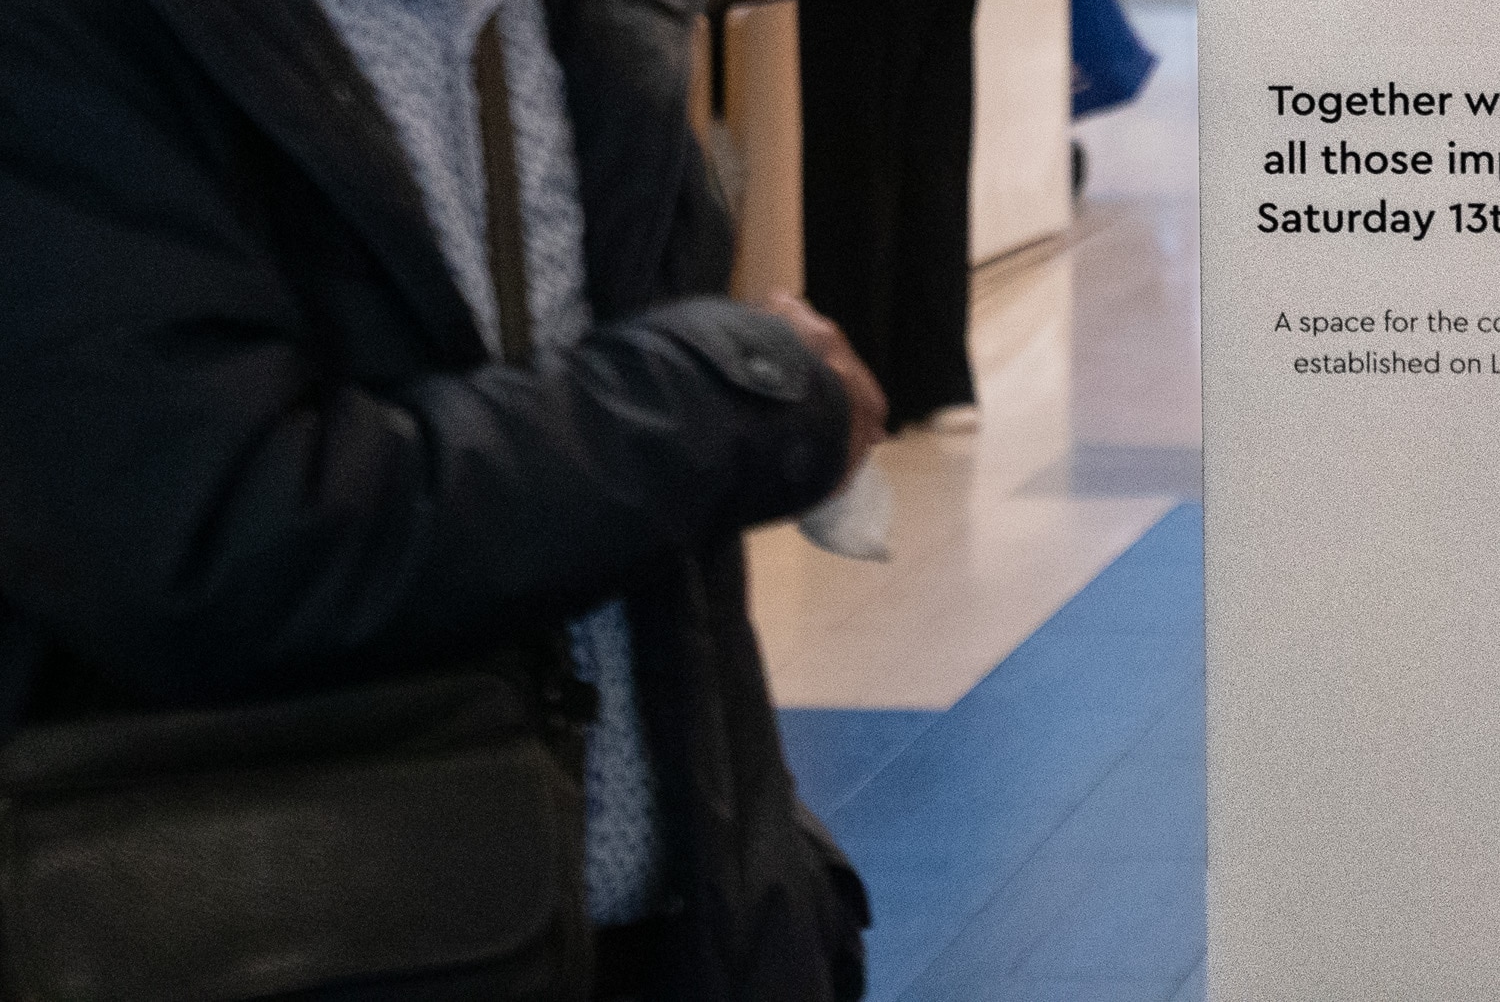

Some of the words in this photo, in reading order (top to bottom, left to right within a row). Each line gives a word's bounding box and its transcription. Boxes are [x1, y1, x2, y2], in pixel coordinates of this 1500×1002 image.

[1267, 81, 1453, 125] Together
[1263, 139, 1307, 176] all
[1320, 139, 1434, 176] those
[1257, 198, 1436, 242] Saturday
[1273, 311, 1292, 334] A
[1299, 315, 1376, 342] space
[1383, 308, 1418, 334] for
[1426, 310, 1469, 334] the
[1292, 351, 1441, 376] established
[1449, 357, 1482, 376] on
